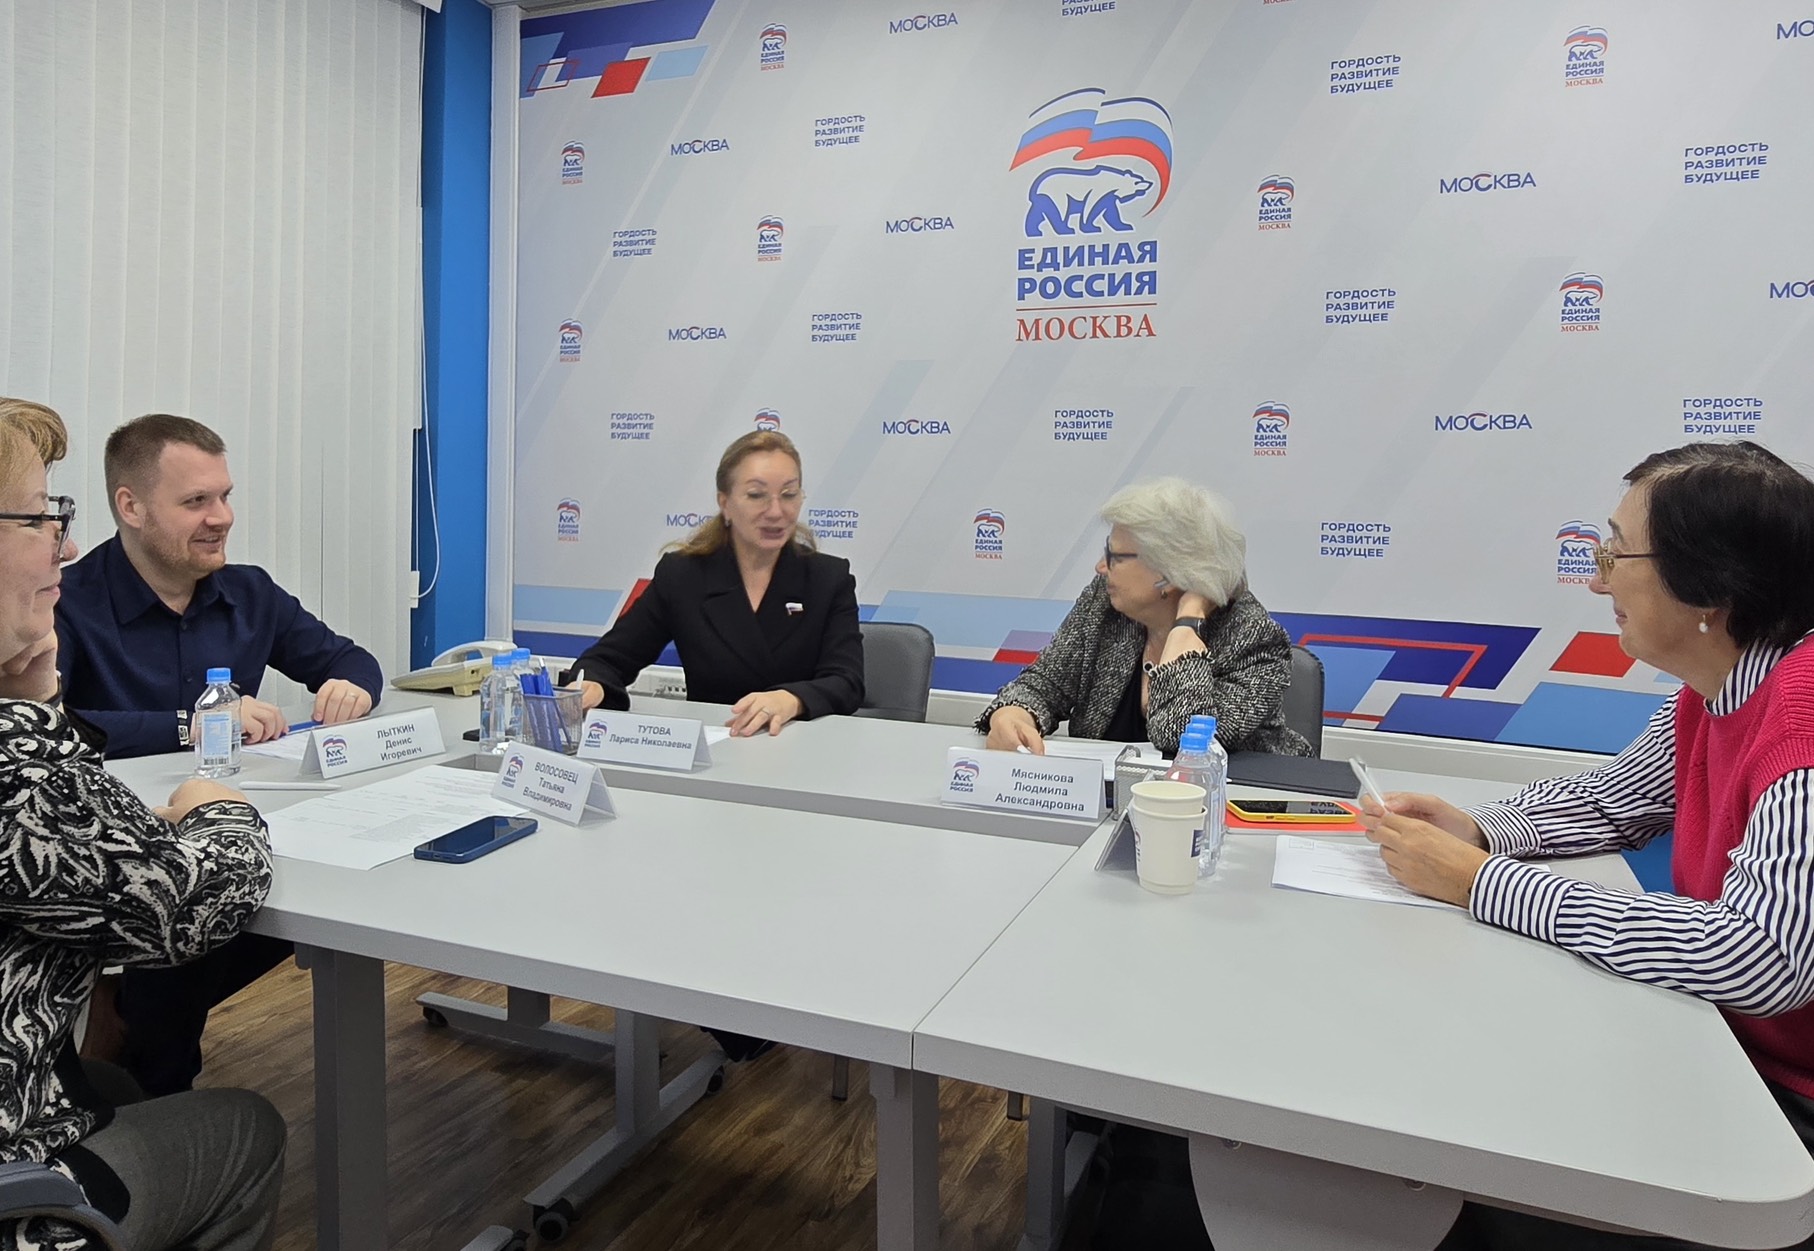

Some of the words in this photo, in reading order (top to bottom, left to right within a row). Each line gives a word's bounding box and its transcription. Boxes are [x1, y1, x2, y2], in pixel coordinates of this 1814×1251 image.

[1062, 2, 1116, 16] БУДУЩЕЕ
[889, 13, 958, 34] МОСКВА
[1331, 54, 1401, 70] ГОРДОСТЬ
[1566, 61, 1604, 70] ЕДИНАЯ
[1331, 67, 1399, 81] РАЗВИТИЕ
[1566, 69, 1604, 77] РОССИЯ
[1331, 80, 1394, 93] БУДУЩЕЕ
[815, 115, 865, 127] ГОРДОСТЬ
[815, 124, 864, 136] РАЗВИТИЕ
[671, 139, 729, 155] МОСКВА
[815, 136, 860, 147] БУДУЩЕЕ
[1685, 142, 1769, 157] ГОРДОСТЬ
[1685, 157, 1767, 170] РАЗВИТИЕ
[1440, 172, 1536, 193] МОСКВА
[1685, 170, 1760, 184] БУДУЩЕЕ
[886, 217, 954, 234] МОСКВА
[613, 229, 657, 238] ГОРДОСТЬ
[613, 239, 656, 247] РАЗВИТИЕ
[613, 249, 652, 257] БУДУЩЕЕ
[1018, 241, 1157, 271] ЕДИНАЯ
[1018, 271, 1157, 300] РОССИЯ
[1326, 288, 1396, 300] ГОРДОСТЬ
[1326, 301, 1395, 311] РАЗВИТИЕ
[812, 313, 862, 321] ГОРДОСТЬ
[1326, 314, 1388, 324] БУДУЩЕЕ
[669, 326, 726, 340] МОСКВА
[1016, 313, 1156, 341] МОСКВА
[812, 333, 857, 342] БУДУЩЕЕ
[1684, 399, 1763, 408] ГОРДОСТЬ
[1054, 409, 1113, 419] ГОРДОСТЬ
[1684, 412, 1762, 420] РАЗВИТИЕ
[883, 419, 951, 434] МОСКВА
[1054, 421, 1113, 429] РАЗВИТИЕ
[1435, 413, 1532, 431] МОСКВА
[1685, 425, 1756, 434] БУДУЩЕЕ
[611, 432, 650, 440] БУДУЩЕЕ
[1054, 432, 1108, 441] БУДУЩЕЕ
[808, 509, 858, 518] ГОРДОСТЬ
[666, 513, 713, 527] МОСК
[808, 520, 858, 528] РАЗВИТИЕ
[809, 530, 854, 538] УДУЩЕЕ
[1321, 523, 1391, 533] ГОРДОСТЬ
[1321, 535, 1390, 545] РАЗВИТИЕ
[1321, 547, 1384, 558] БУДУЩЕЕ
[377, 724, 415, 738] ЛЫТКИН
[638, 725, 671, 735] ТУТОВА
[385, 737, 412, 749] Денис
[609, 734, 639, 745] Лариса
[641, 738, 692, 749] Николаевна
[380, 747, 422, 761] Игоревич
[535, 762, 579, 784] ВОЛОСОВЕЦ
[1011, 768, 1074, 783] Мясникова
[539, 777, 564, 793] Татьяна
[1013, 782, 1068, 796] Людмила
[523, 787, 572, 810] Владимировна
[995, 793, 1084, 811] Александровна
